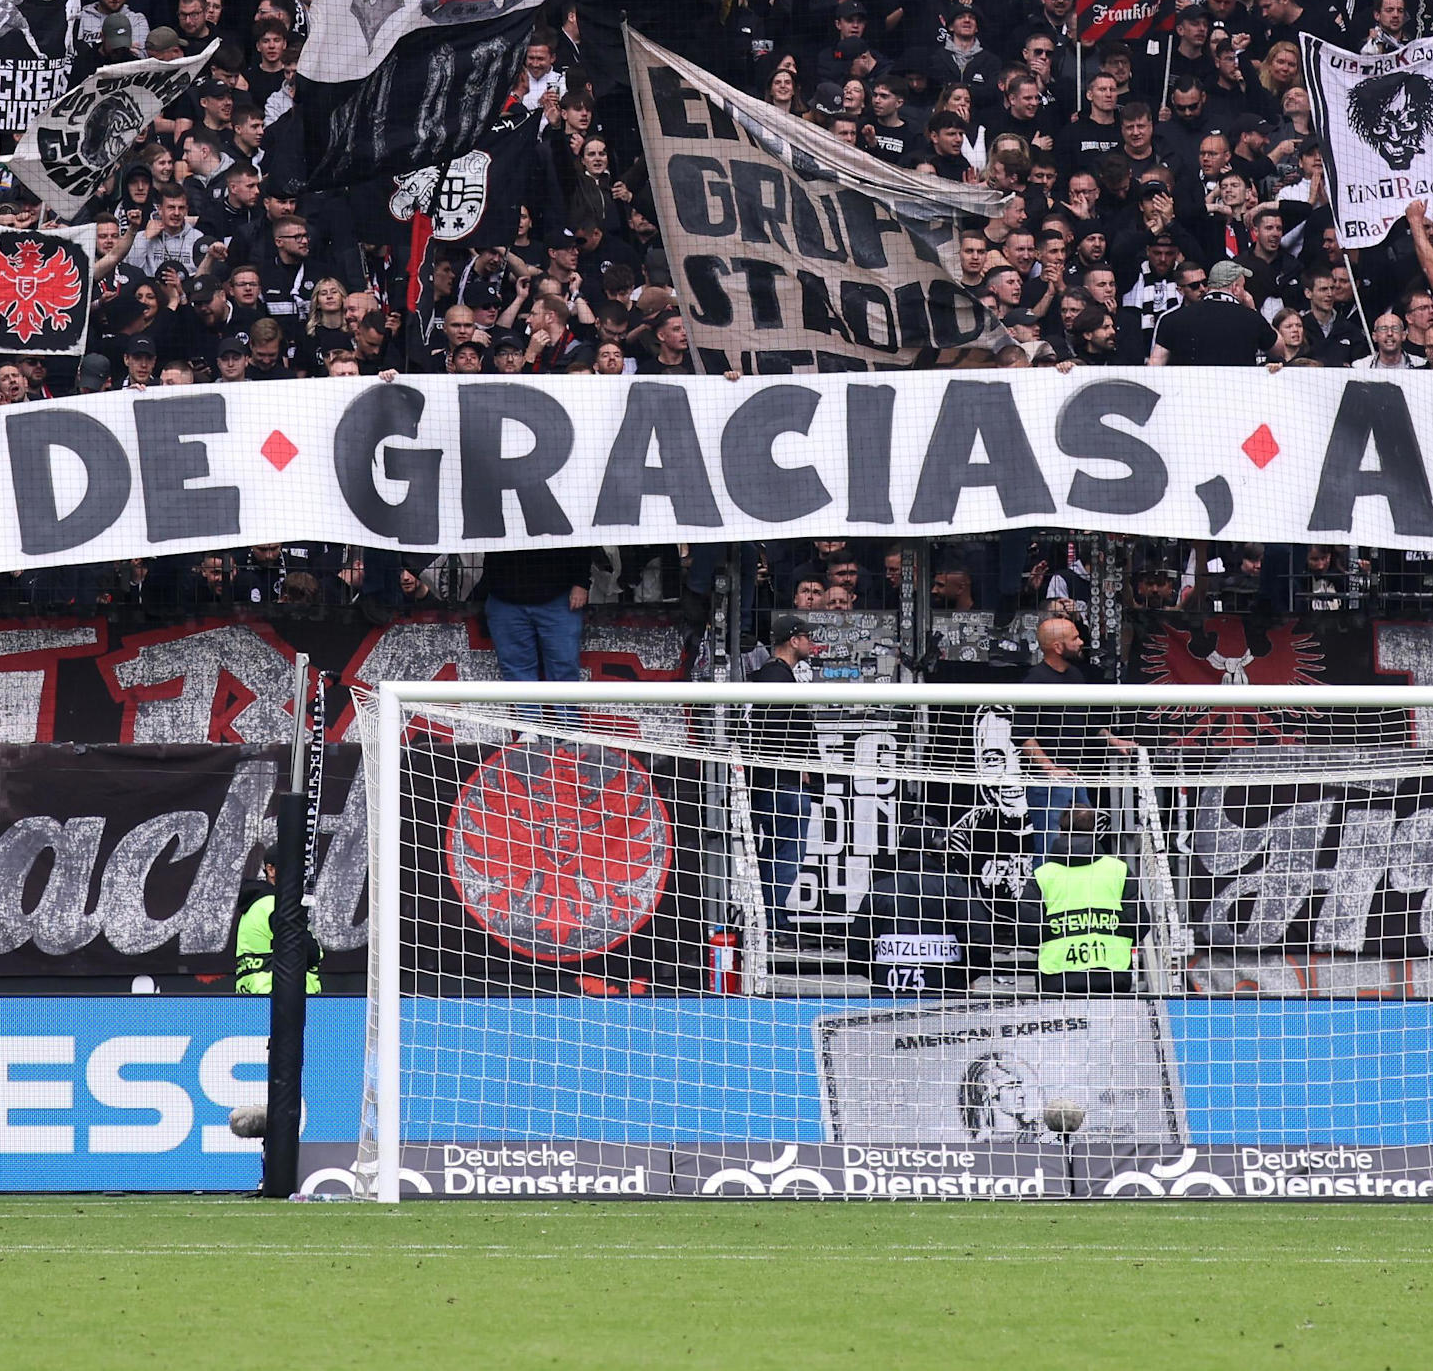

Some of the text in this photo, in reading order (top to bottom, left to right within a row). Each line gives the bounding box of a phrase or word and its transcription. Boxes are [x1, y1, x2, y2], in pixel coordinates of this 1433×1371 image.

[17, 56, 46, 71] WIE
[5, 394, 242, 558] DE
[1049, 912, 1120, 935] STEWARD
[886, 968, 927, 992] 075
[893, 1016, 1089, 1052] AMERICAN EXPRESS
[443, 1144, 577, 1170] Deutsche
[843, 1144, 976, 1170] Deutsche
[1241, 1147, 1374, 1173] Deutsche
[444, 1165, 647, 1195] Dienstrad
[844, 1165, 1045, 1195] Dienstrad
